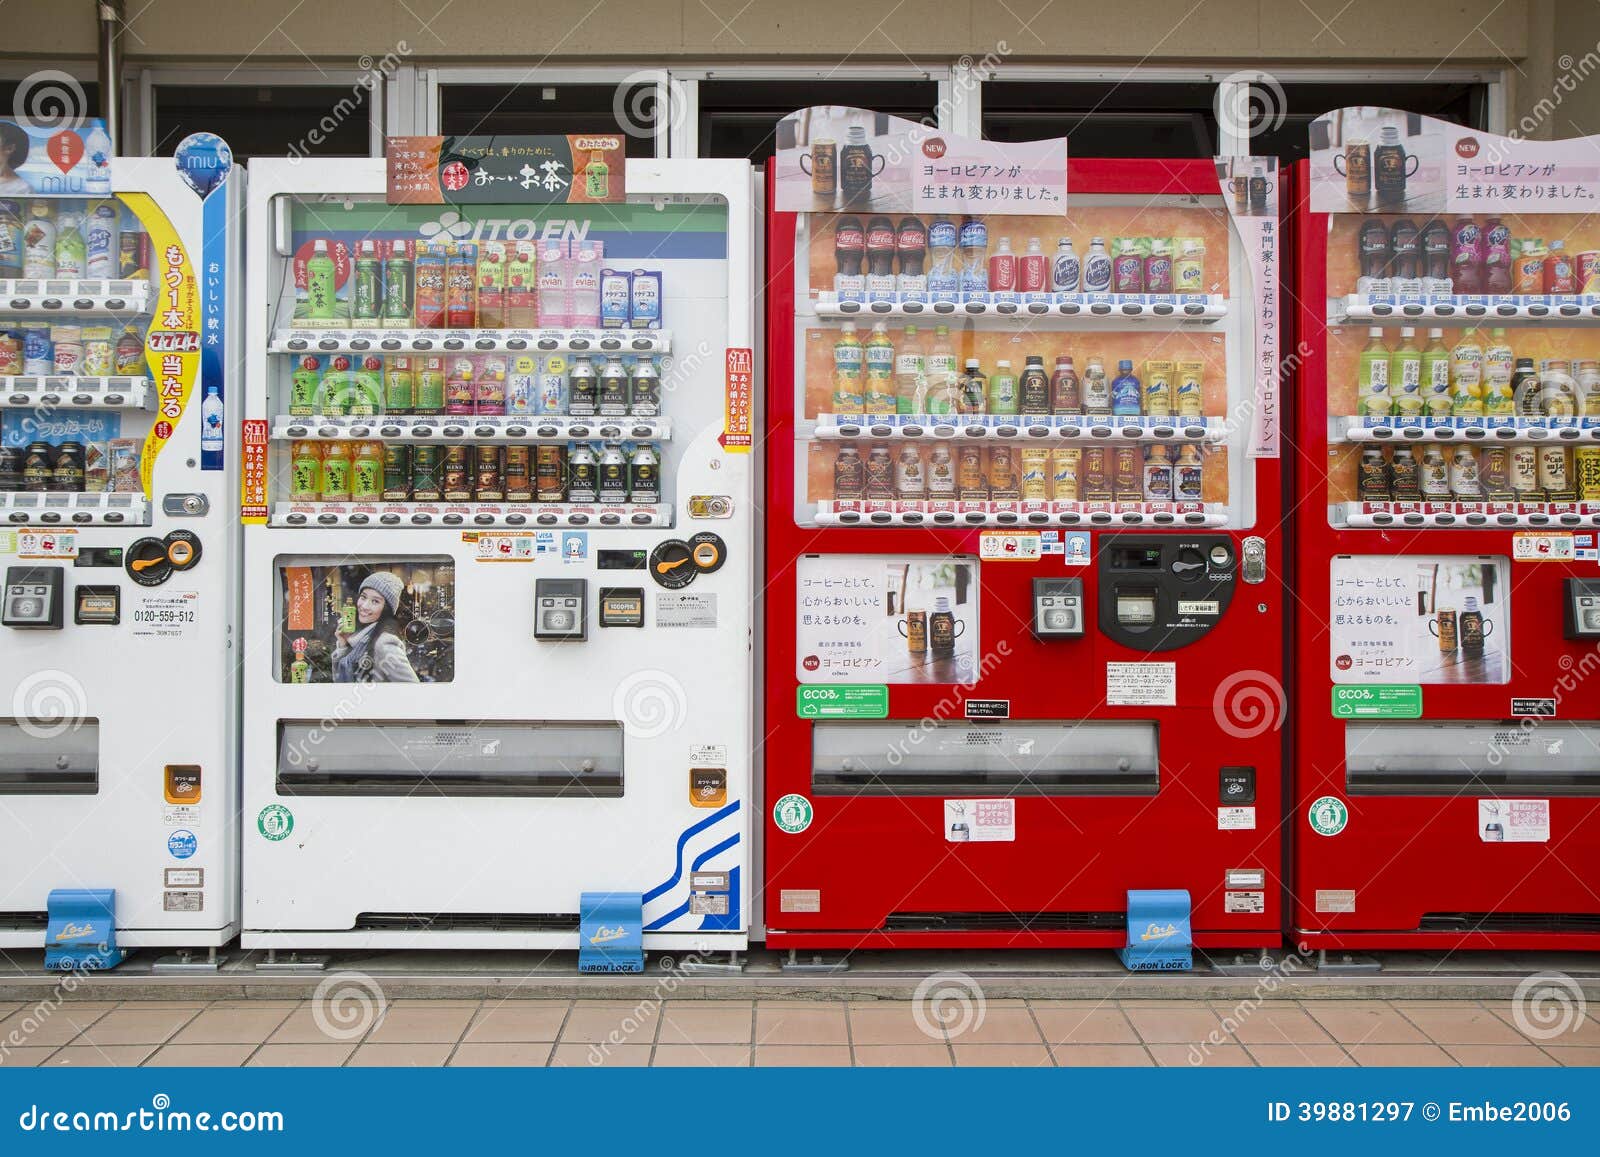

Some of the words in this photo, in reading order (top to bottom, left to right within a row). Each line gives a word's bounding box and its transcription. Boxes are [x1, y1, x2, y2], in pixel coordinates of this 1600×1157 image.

[577, 140, 618, 148] あたたかい
[925, 145, 943, 153] NEW
[1459, 144, 1476, 152] NEW
[923, 164, 1021, 178] ヨーロピアンが
[1457, 164, 1556, 177] ヨーロピアンが
[922, 185, 1059, 201] 生まれ変わりました。
[1456, 185, 1595, 199] 生まれ変わりました。
[472, 219, 536, 241] ITO
[541, 219, 591, 241] EN
[165, 245, 184, 329] もう1本
[541, 278, 563, 286] evian
[575, 278, 597, 286] evian
[1260, 222, 1275, 346] 専門家とこだわった
[208, 262, 219, 345] おいしい軟水
[162, 354, 183, 418] 当たる
[740, 375, 748, 432] あたたかい飲料
[256, 446, 264, 503] あたたかい飲料
[804, 578, 875, 588] コーヒーとして、
[1336, 578, 1407, 588] コーヒーとして、
[803, 597, 880, 607] 心からおいしいと
[1336, 597, 1412, 606] 心からおいしいと
[134, 610, 194, 622] 0120-559-512
[803, 615, 867, 626] 思えるものを。
[1336, 615, 1398, 625] 思えるものを。
[823, 658, 883, 668] ヨーロピアン
[1355, 657, 1414, 668] ヨーロピアン
